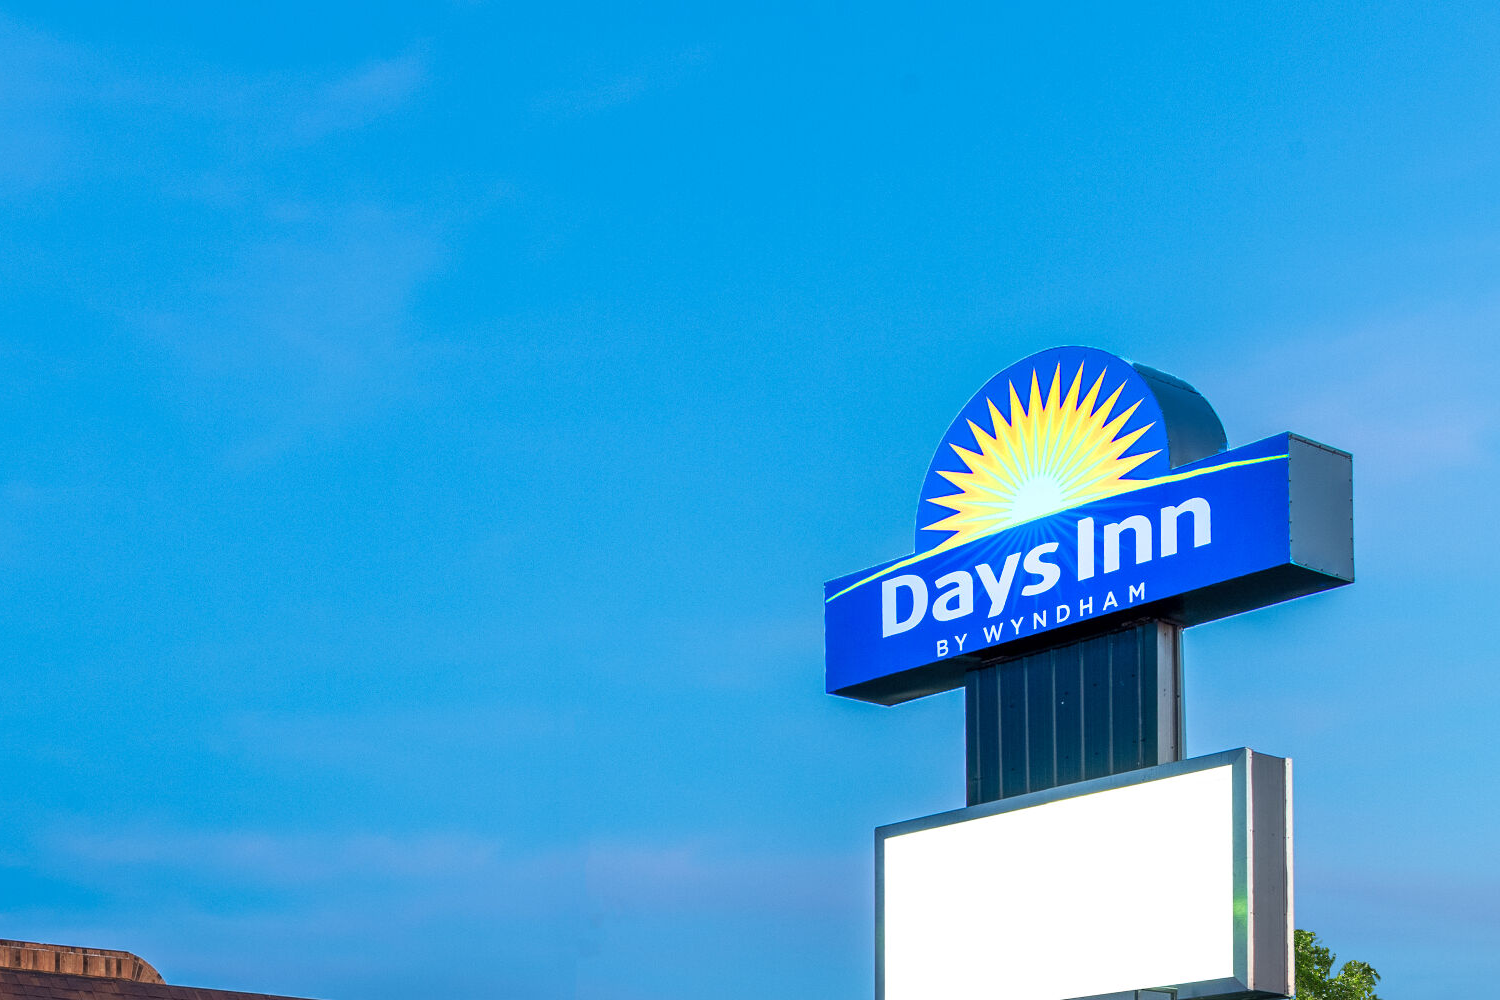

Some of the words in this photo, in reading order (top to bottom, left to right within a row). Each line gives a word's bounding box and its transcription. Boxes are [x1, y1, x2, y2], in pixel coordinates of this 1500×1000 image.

[881, 541, 1062, 638] Days
[1077, 497, 1212, 582] Inn
[936, 632, 968, 658] BY
[982, 581, 1146, 644] WYNDHAM
